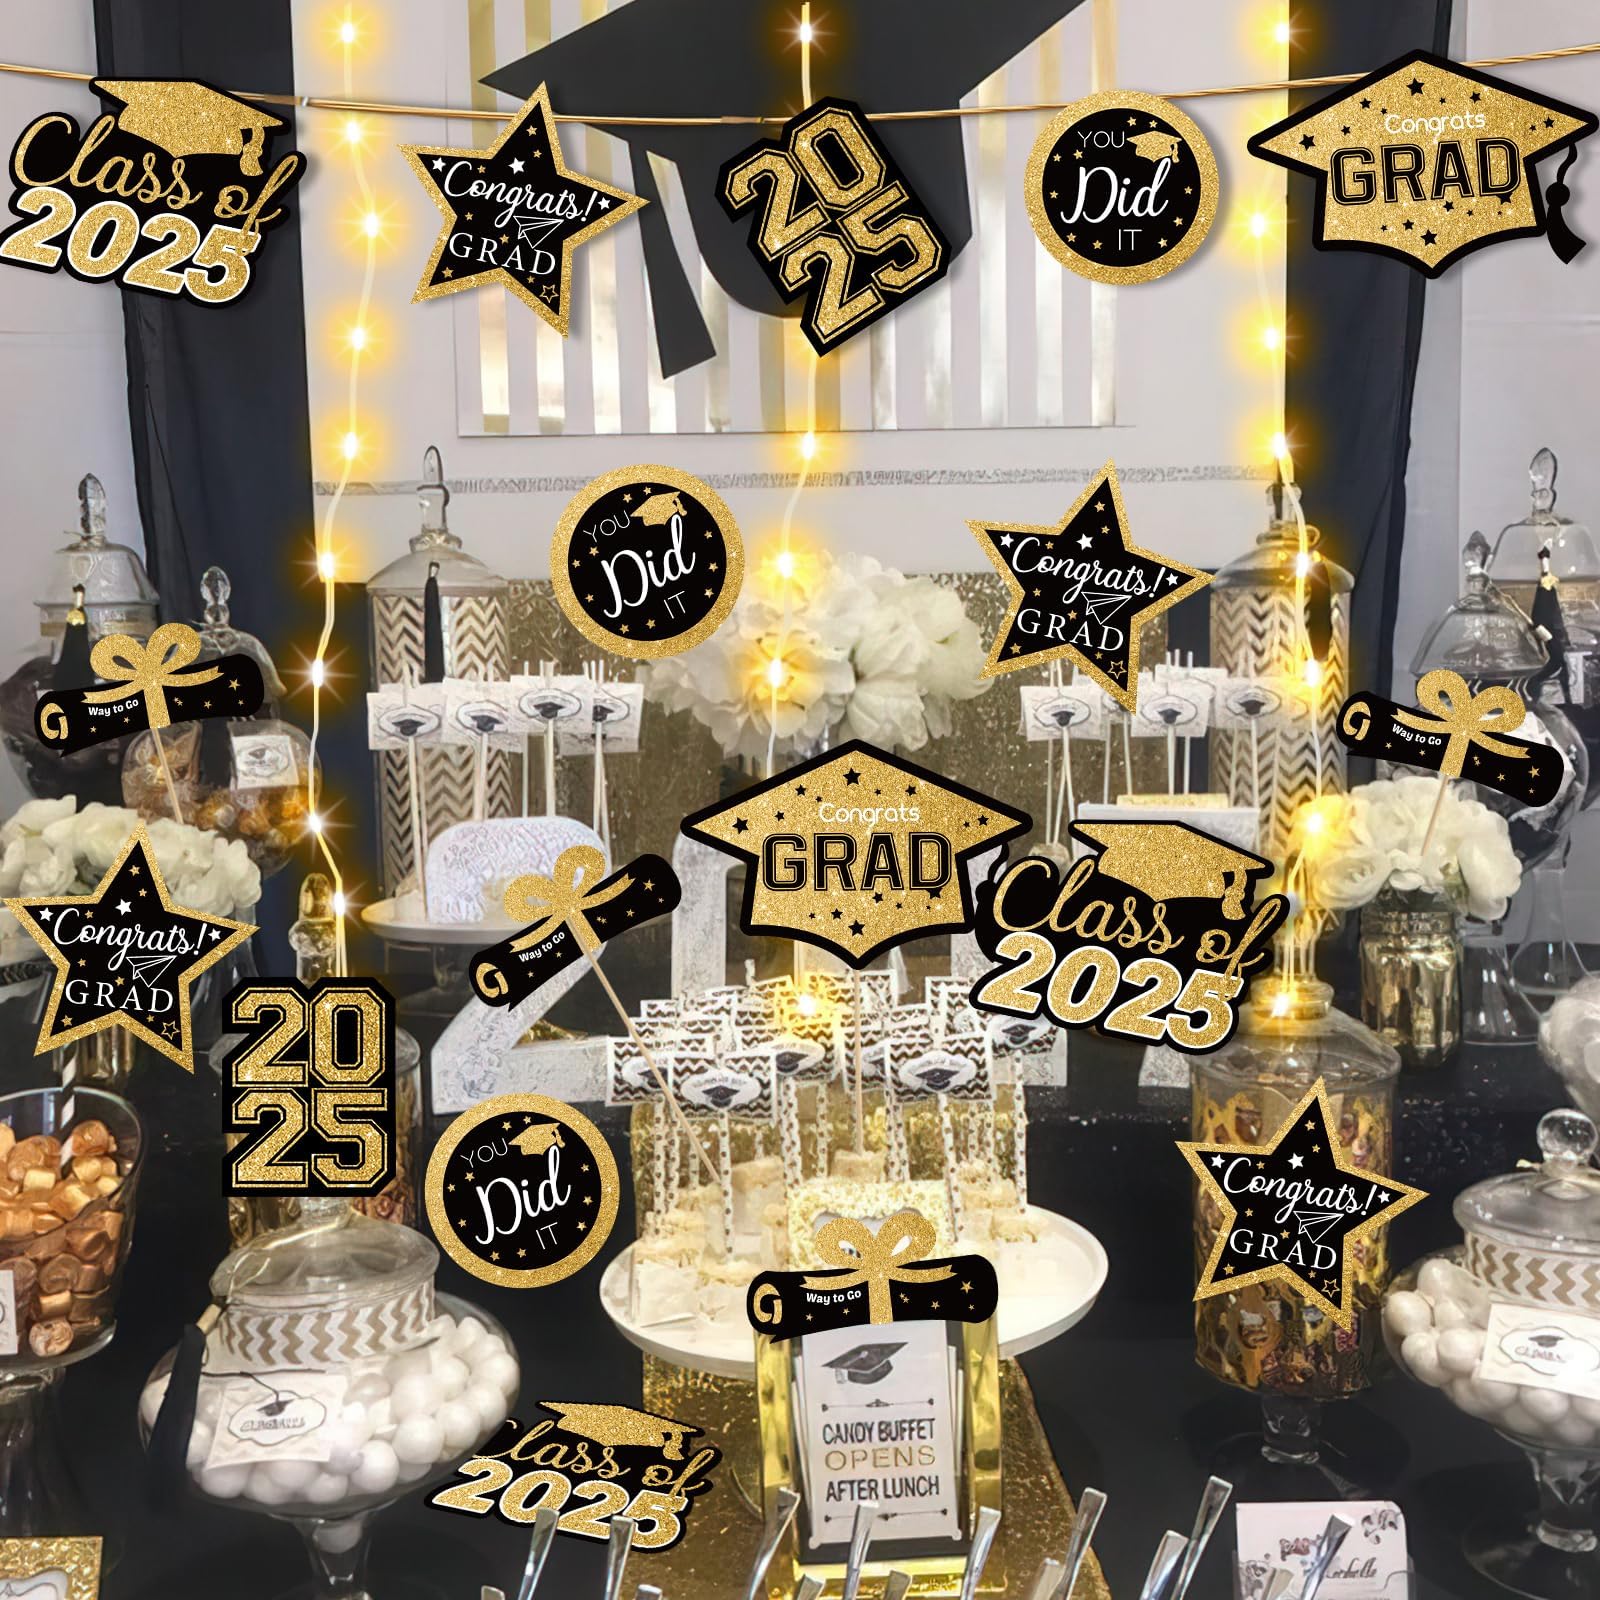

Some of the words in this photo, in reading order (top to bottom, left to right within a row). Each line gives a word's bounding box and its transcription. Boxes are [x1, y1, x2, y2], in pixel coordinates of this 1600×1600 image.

[1077, 130, 1125, 149] YOU
[1384, 110, 1487, 138] Congrats
[14, 115, 203, 210] Class
[213, 154, 299, 256] of
[1060, 157, 1171, 224] Did
[1330, 137, 1521, 206] GRAD
[443, 160, 598, 229] Congrats!
[0, 186, 262, 303] 2025
[449, 232, 556, 275] GRAD
[1118, 228, 1143, 251] IT
[582, 510, 631, 543] YOU
[601, 514, 696, 618] Did
[1012, 536, 1166, 604] Congrats!
[663, 590, 686, 619] IT
[1017, 608, 1124, 651] GRAD
[88, 706, 111, 717] Way
[113, 703, 124, 713] to
[125, 699, 139, 710] Go
[1391, 723, 1413, 742] Way
[1414, 733, 1426, 744] to
[1428, 735, 1442, 746] Go
[818, 803, 920, 827] Congrats
[762, 831, 952, 892] GRAD
[53, 907, 208, 972] Congrats!
[518, 947, 542, 963] Way
[541, 941, 553, 953] to
[552, 931, 565, 944] Go
[993, 859, 1185, 955] Class
[1195, 898, 1281, 1000] of
[65, 979, 174, 1013] GRAD
[977, 931, 1244, 1049] 2025
[460, 1137, 508, 1169] YOU
[475, 1145, 571, 1245] Did
[1223, 1157, 1377, 1224] Congrats!
[535, 1221, 558, 1250] IT
[1229, 1228, 1337, 1270] GRAD
[806, 1292, 830, 1306] Way
[832, 1293, 845, 1303] to
[847, 1289, 862, 1301] Go
[822, 1420, 875, 1445] CANDY
[878, 1417, 936, 1442] BUFFET
[641, 1448, 715, 1506] of
[825, 1446, 936, 1471] OPENS
[431, 1458, 689, 1548] 2025
[826, 1478, 879, 1503] AFTER
[883, 1475, 940, 1499] LUNCH
